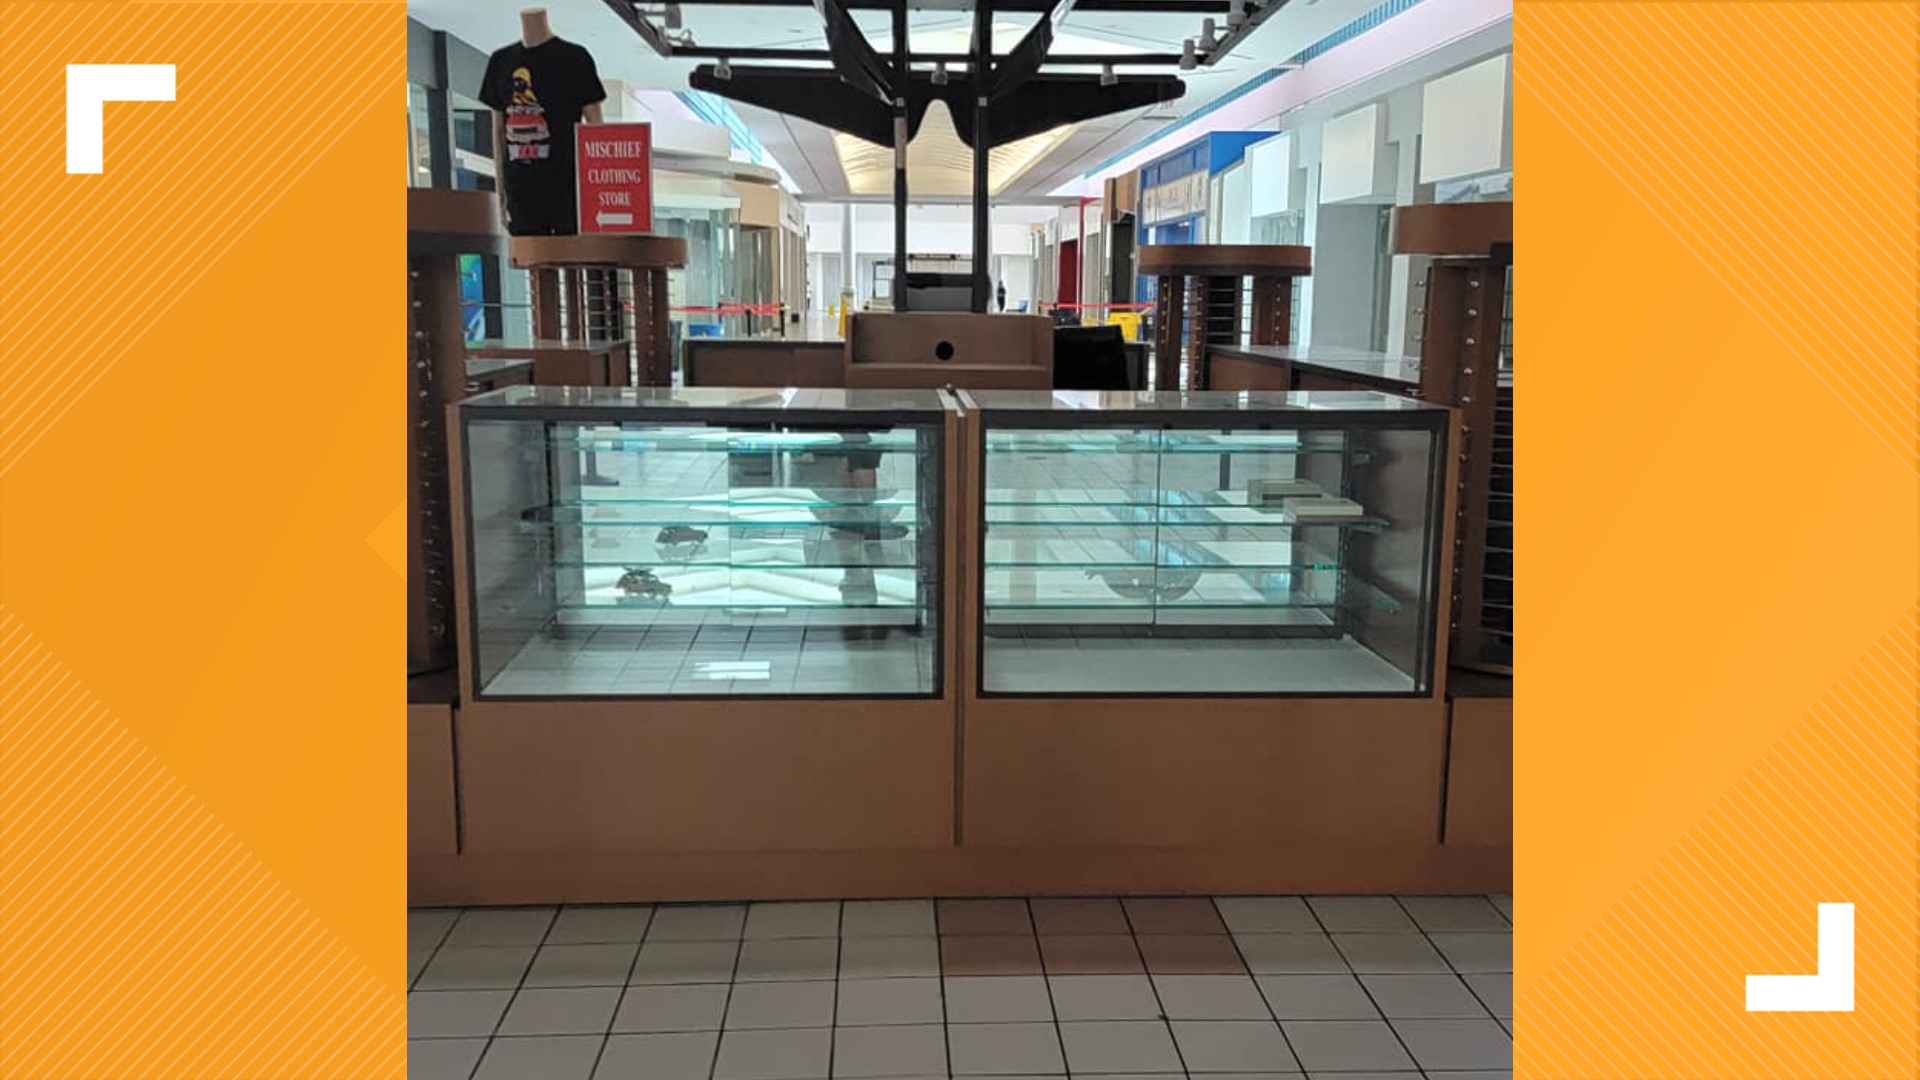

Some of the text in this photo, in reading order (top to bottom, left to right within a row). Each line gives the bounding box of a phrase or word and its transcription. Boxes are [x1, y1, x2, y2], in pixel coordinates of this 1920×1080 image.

[584, 140, 642, 158] MISCHIEF
[588, 169, 641, 184] CLOTHING
[598, 191, 631, 206] STORE
